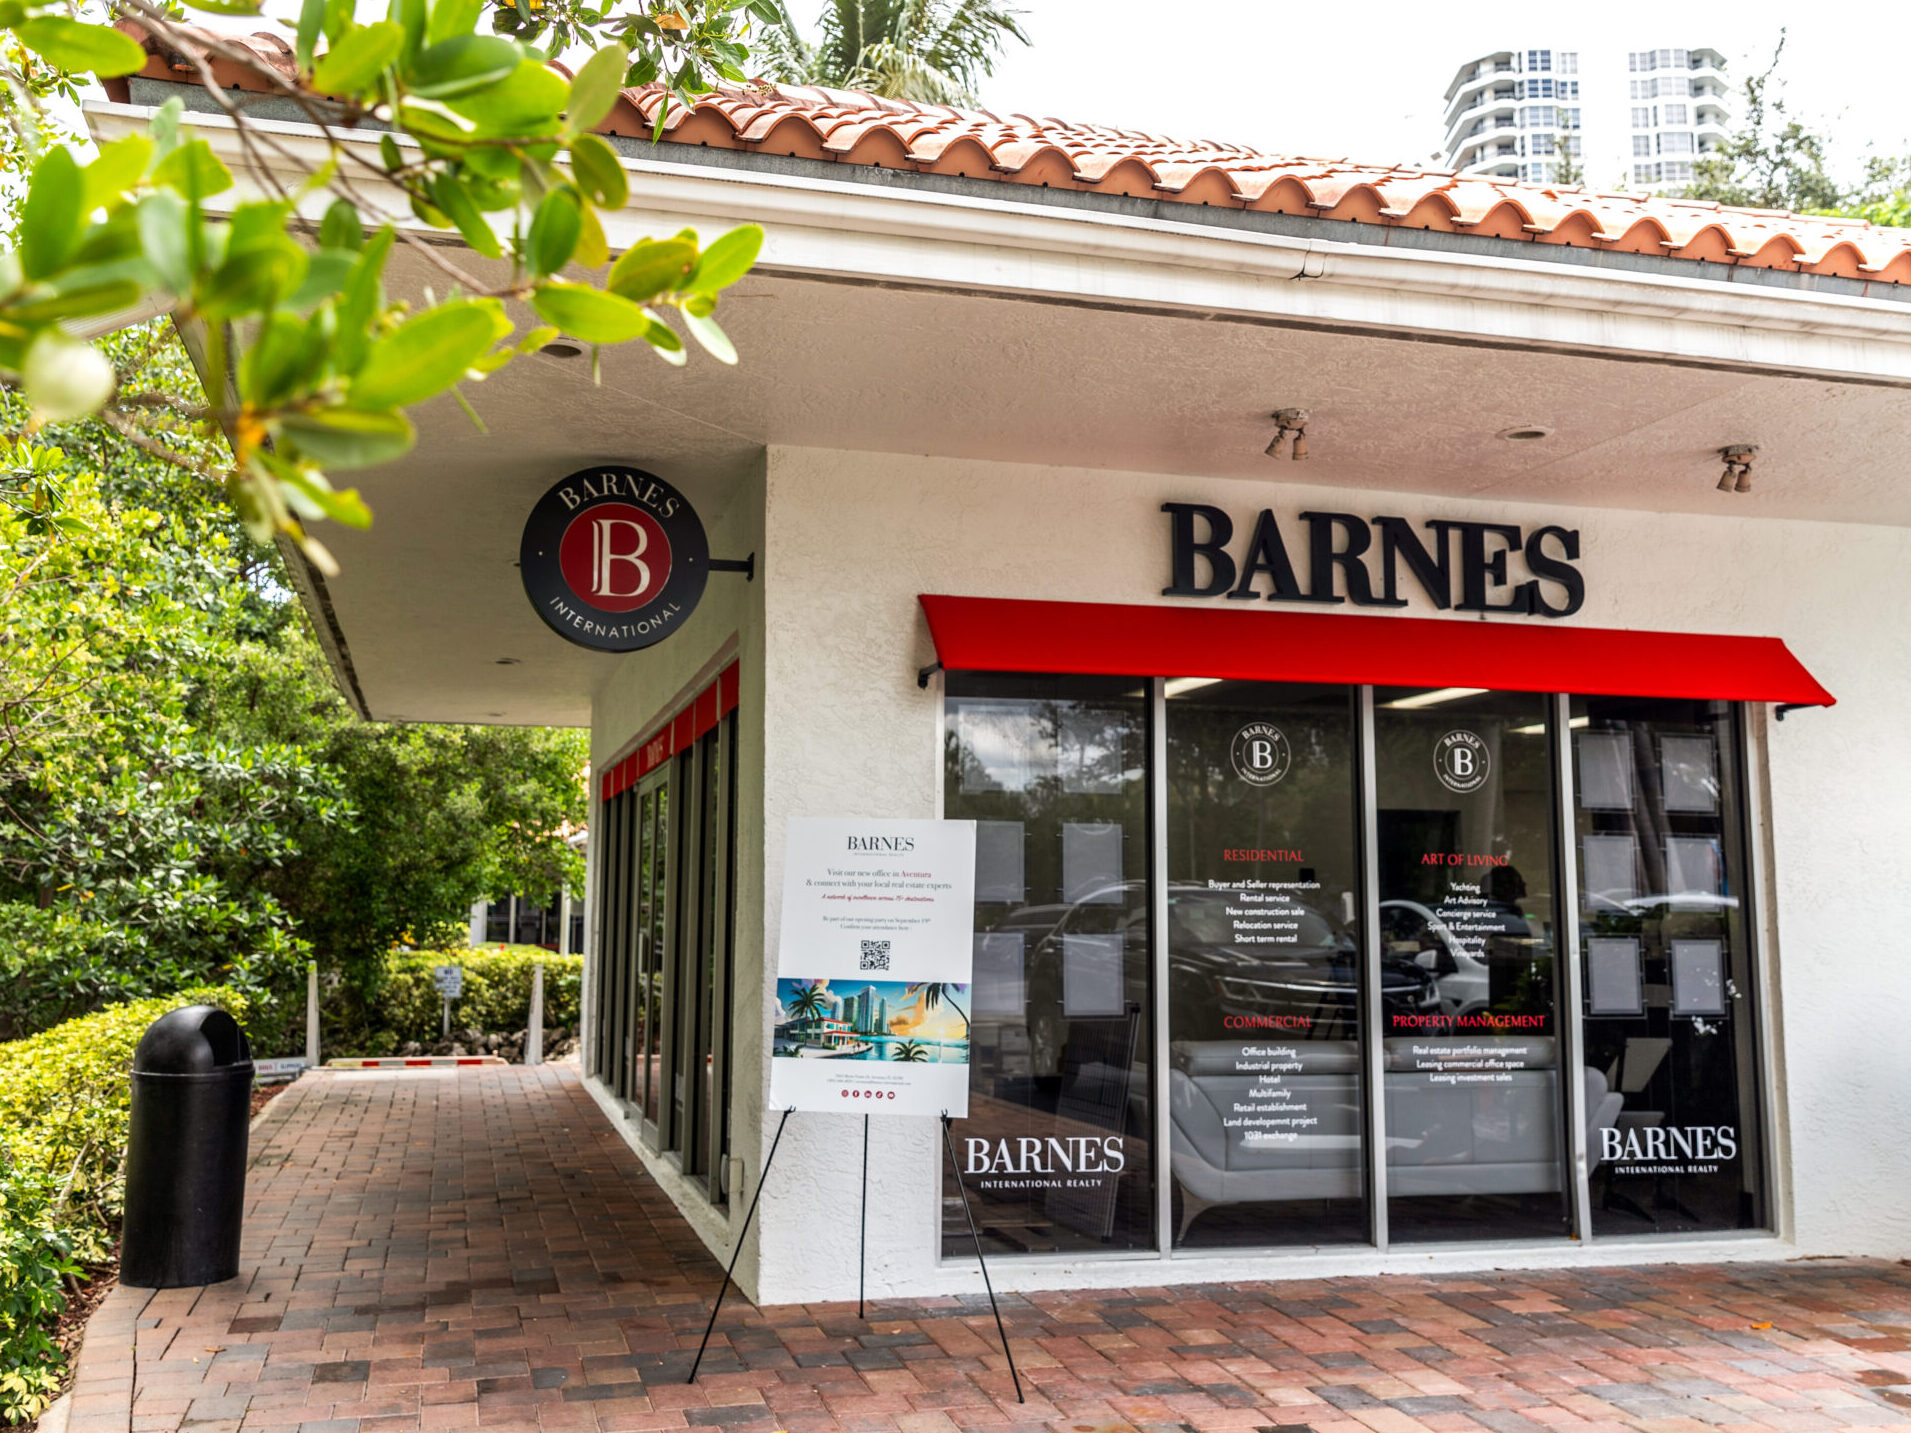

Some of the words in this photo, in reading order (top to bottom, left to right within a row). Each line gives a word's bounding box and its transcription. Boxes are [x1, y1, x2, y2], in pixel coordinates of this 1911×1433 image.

[558, 473, 681, 518] BARNES
[591, 519, 651, 597] B
[1161, 502, 1585, 618] BARNES
[550, 596, 681, 638] INTERNATIONAL
[1241, 725, 1280, 741] BARNES
[1443, 733, 1481, 749] BARNES
[1252, 740, 1272, 768] B
[1454, 747, 1473, 775] B
[1241, 767, 1282, 781] INTERNATIONAL
[847, 836, 915, 852] BARNES
[1224, 849, 1304, 862] RESIDENTIAL
[1421, 853, 1445, 865] ART
[1447, 854, 1465, 866] OF
[1467, 855, 1508, 867] LIVING
[827, 868, 843, 876] Visit
[872, 869, 891, 877] office
[901, 870, 932, 878] Aventura
[856, 881, 873, 889] your
[874, 880, 890, 888] local
[927, 883, 952, 891] experts
[1208, 880, 1231, 890] Buyer
[1232, 880, 1246, 888] and
[1246, 880, 1267, 889] Seller
[1268, 881, 1320, 891] representation
[1450, 882, 1481, 894] Yachting
[1240, 893, 1264, 902] Rental
[1265, 894, 1290, 902] service
[1444, 895, 1457, 904] Art
[1457, 895, 1488, 907] Advisory
[1226, 907, 1243, 915] New
[1244, 907, 1289, 916] construction
[1291, 907, 1305, 916] sale
[1436, 908, 1471, 920] Concierge
[1473, 909, 1496, 918] service
[1233, 920, 1272, 929] Relocation
[1273, 921, 1298, 929] service
[1448, 922, 1455, 930] &
[1456, 922, 1506, 931] Entertainment
[1235, 934, 1255, 943] Short
[1276, 934, 1298, 942] rental
[1449, 935, 1486, 947] Hospitality
[1224, 1015, 1312, 1029] COMMERCIAL
[1392, 1015, 1453, 1028] PROPERTY
[1457, 1015, 1545, 1028] MANAGEMENT
[1242, 1047, 1266, 1056] Office
[1267, 1047, 1296, 1058] building
[1413, 1045, 1428, 1055] Real
[1430, 1047, 1450, 1055] estate
[1452, 1045, 1482, 1057] portfolio
[1483, 1047, 1527, 1057] management
[1236, 1061, 1270, 1071] Industrial
[1271, 1062, 1303, 1072] property
[1416, 1060, 1442, 1070] Leasing
[1444, 1059, 1484, 1068] commercial
[1485, 1059, 1504, 1068] office
[1505, 1061, 1524, 1070] space
[1259, 1075, 1280, 1084] Hotel
[1430, 1074, 1456, 1084] Leasing
[1457, 1074, 1495, 1082] investment
[1496, 1073, 1512, 1082] sales
[1249, 1088, 1291, 1099] Multifamily
[1234, 1103, 1255, 1112] Retail
[1257, 1103, 1307, 1112] establishment
[1223, 1117, 1241, 1126] Land
[1291, 1116, 1317, 1128] project
[1244, 1131, 1262, 1140] 1031
[1263, 1130, 1298, 1142] exchange
[1599, 1126, 1737, 1161] BARNES
[964, 1136, 1125, 1173] BARNES
[1615, 1165, 1684, 1174] INTERNATIONAL
[1687, 1165, 1719, 1173] REALTY
[981, 1179, 1062, 1189] INTERNATIONAL
[1067, 1179, 1102, 1187] REALTY
